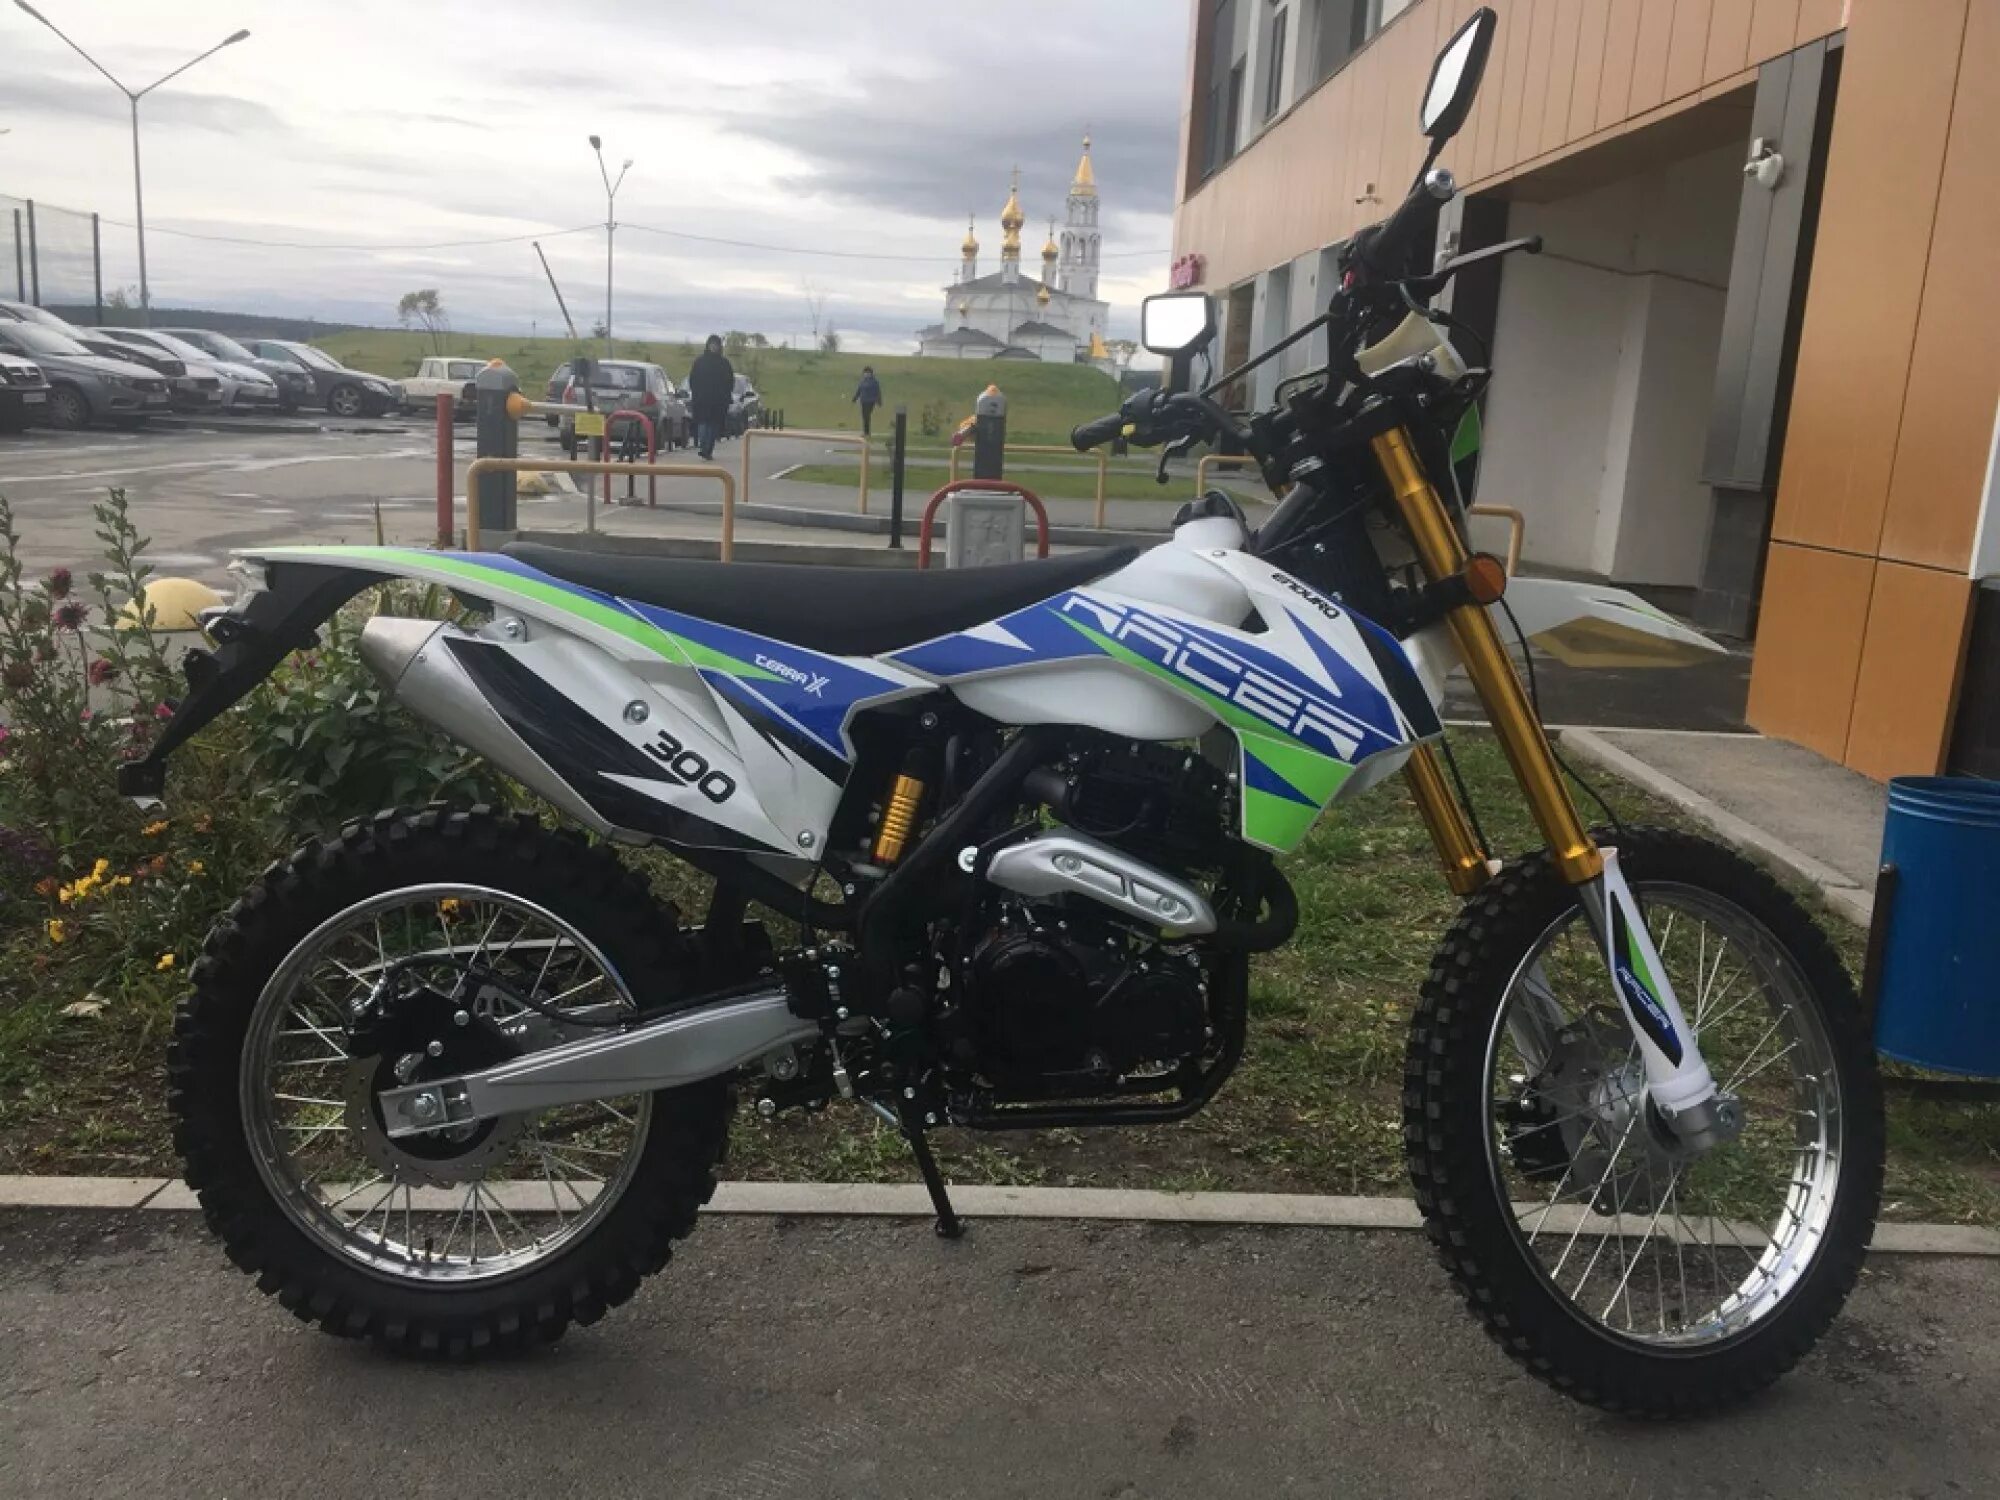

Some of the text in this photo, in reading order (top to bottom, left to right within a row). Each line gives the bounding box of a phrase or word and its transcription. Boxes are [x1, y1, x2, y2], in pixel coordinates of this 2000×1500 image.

[1271, 573, 1340, 619] ENDURO
[1062, 596, 1366, 762] RACER
[642, 729, 736, 804] 300
